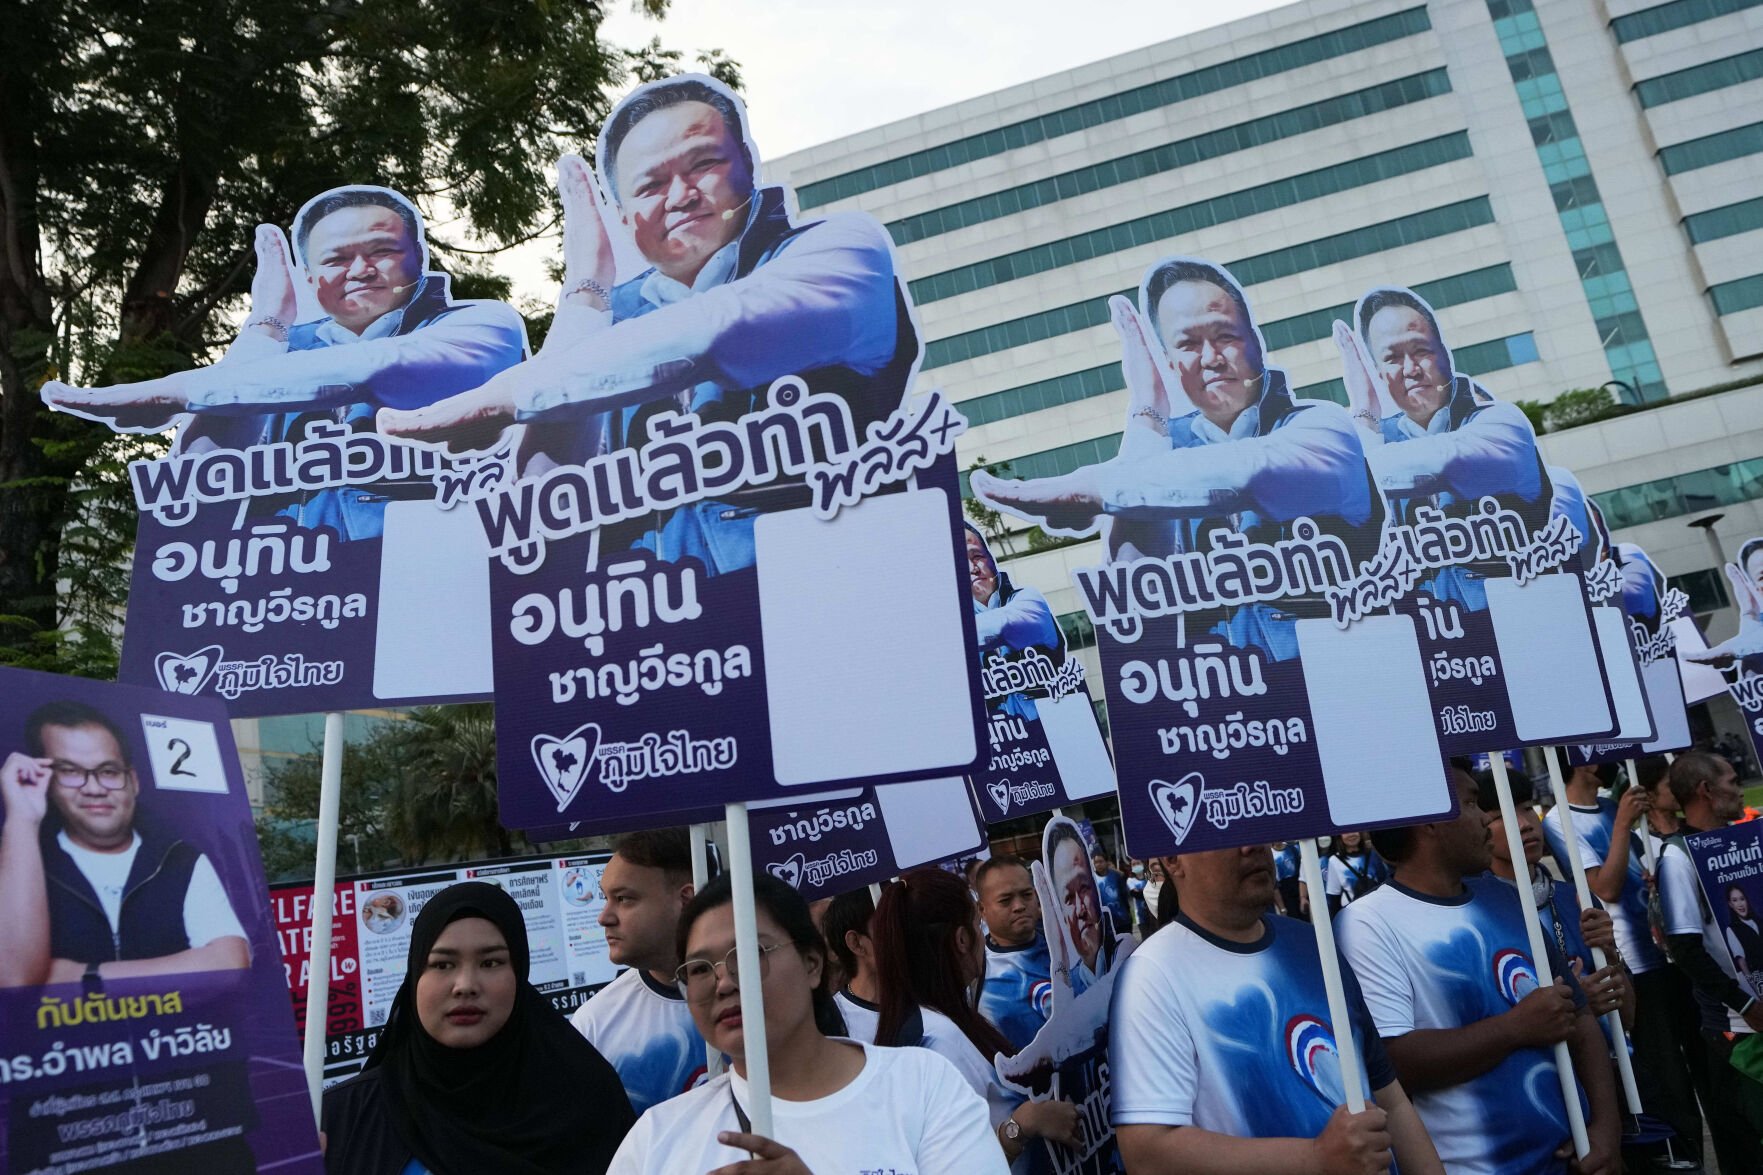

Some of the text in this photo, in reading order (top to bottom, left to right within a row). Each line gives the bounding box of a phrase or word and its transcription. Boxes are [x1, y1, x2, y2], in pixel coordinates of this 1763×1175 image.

[474, 379, 853, 571] พูดแล้วทำ
[152, 524, 331, 593] อนุทิน
[1073, 518, 1351, 642] พูดแล้วทำ
[182, 588, 366, 632] ชาญวีรกูล
[510, 560, 702, 656] อนุทิน
[215, 653, 344, 699] ภูมิใจไทย
[549, 643, 752, 705] ชาญวีรกูล
[1120, 643, 1267, 718] อนุทิน
[167, 738, 197, 777] 2
[599, 730, 738, 792] ภูมิใจไทย
[1157, 711, 1307, 759] ชาญวีรกูล
[1205, 781, 1305, 830] ภูมิใจไทย
[807, 849, 878, 887] ภูมิใจไทย
[36, 990, 183, 1029] กัปตันยาส
